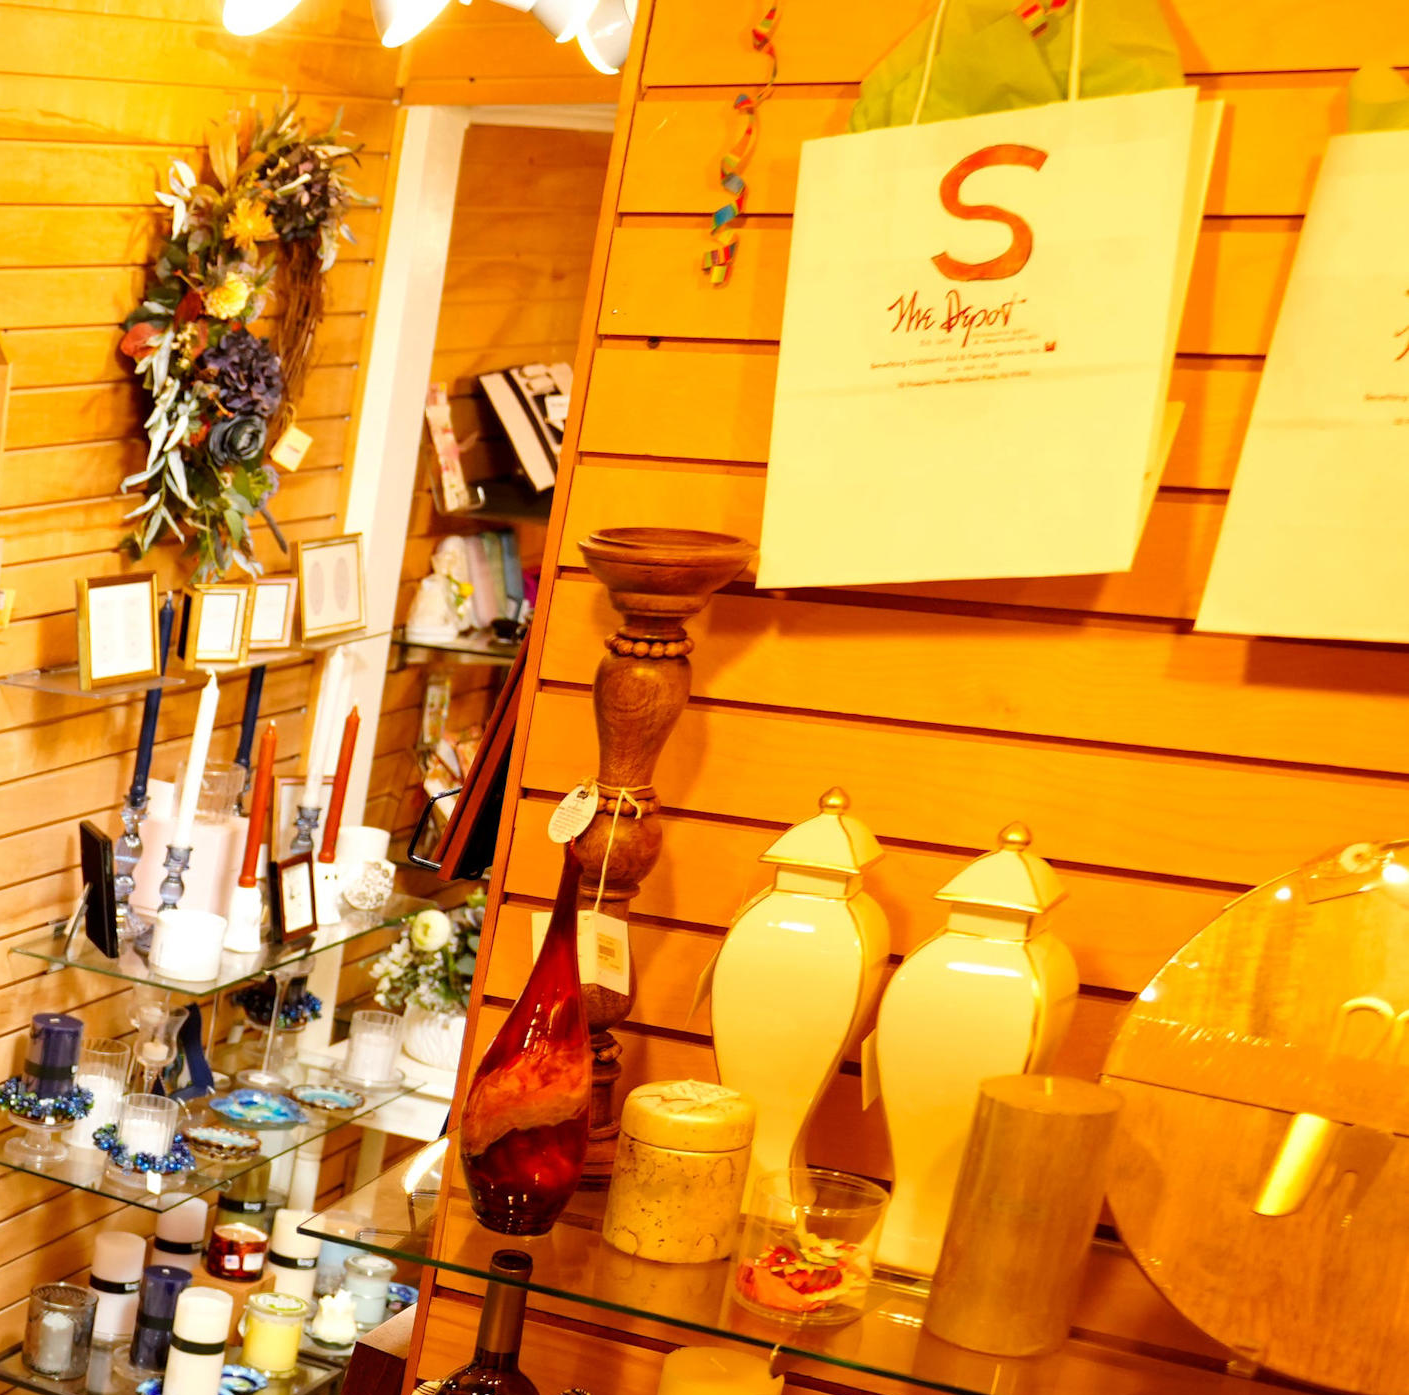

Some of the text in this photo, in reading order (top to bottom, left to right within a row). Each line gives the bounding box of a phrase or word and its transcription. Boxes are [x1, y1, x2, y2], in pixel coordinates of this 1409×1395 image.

[931, 143, 1048, 282] S
[887, 288, 1028, 348] The Depot
